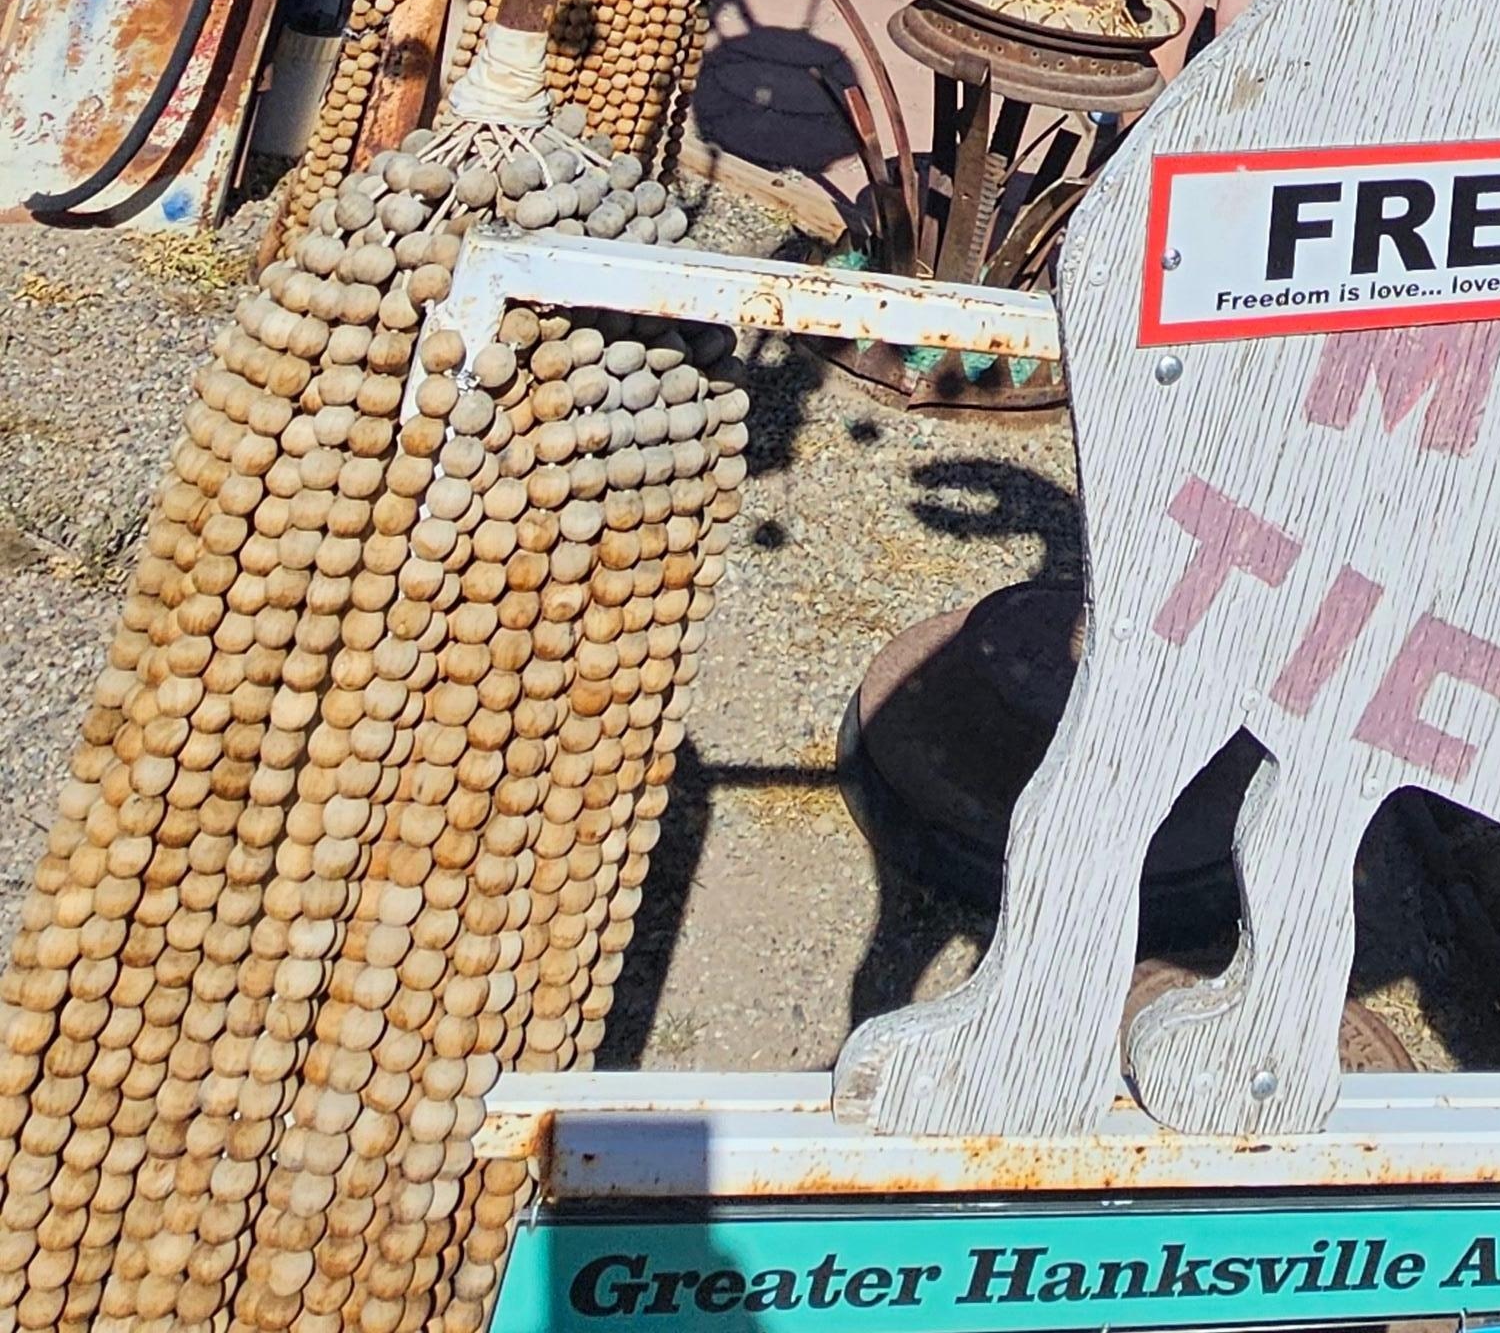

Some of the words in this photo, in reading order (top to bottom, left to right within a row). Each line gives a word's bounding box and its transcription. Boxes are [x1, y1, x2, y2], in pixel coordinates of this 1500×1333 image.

[1215, 285, 1330, 312] Freedom
[1339, 284, 1360, 303] is
[1368, 278, 1443, 301] love...
[569, 1252, 940, 1318] Greater
[954, 1237, 1421, 1303] Hanksville
